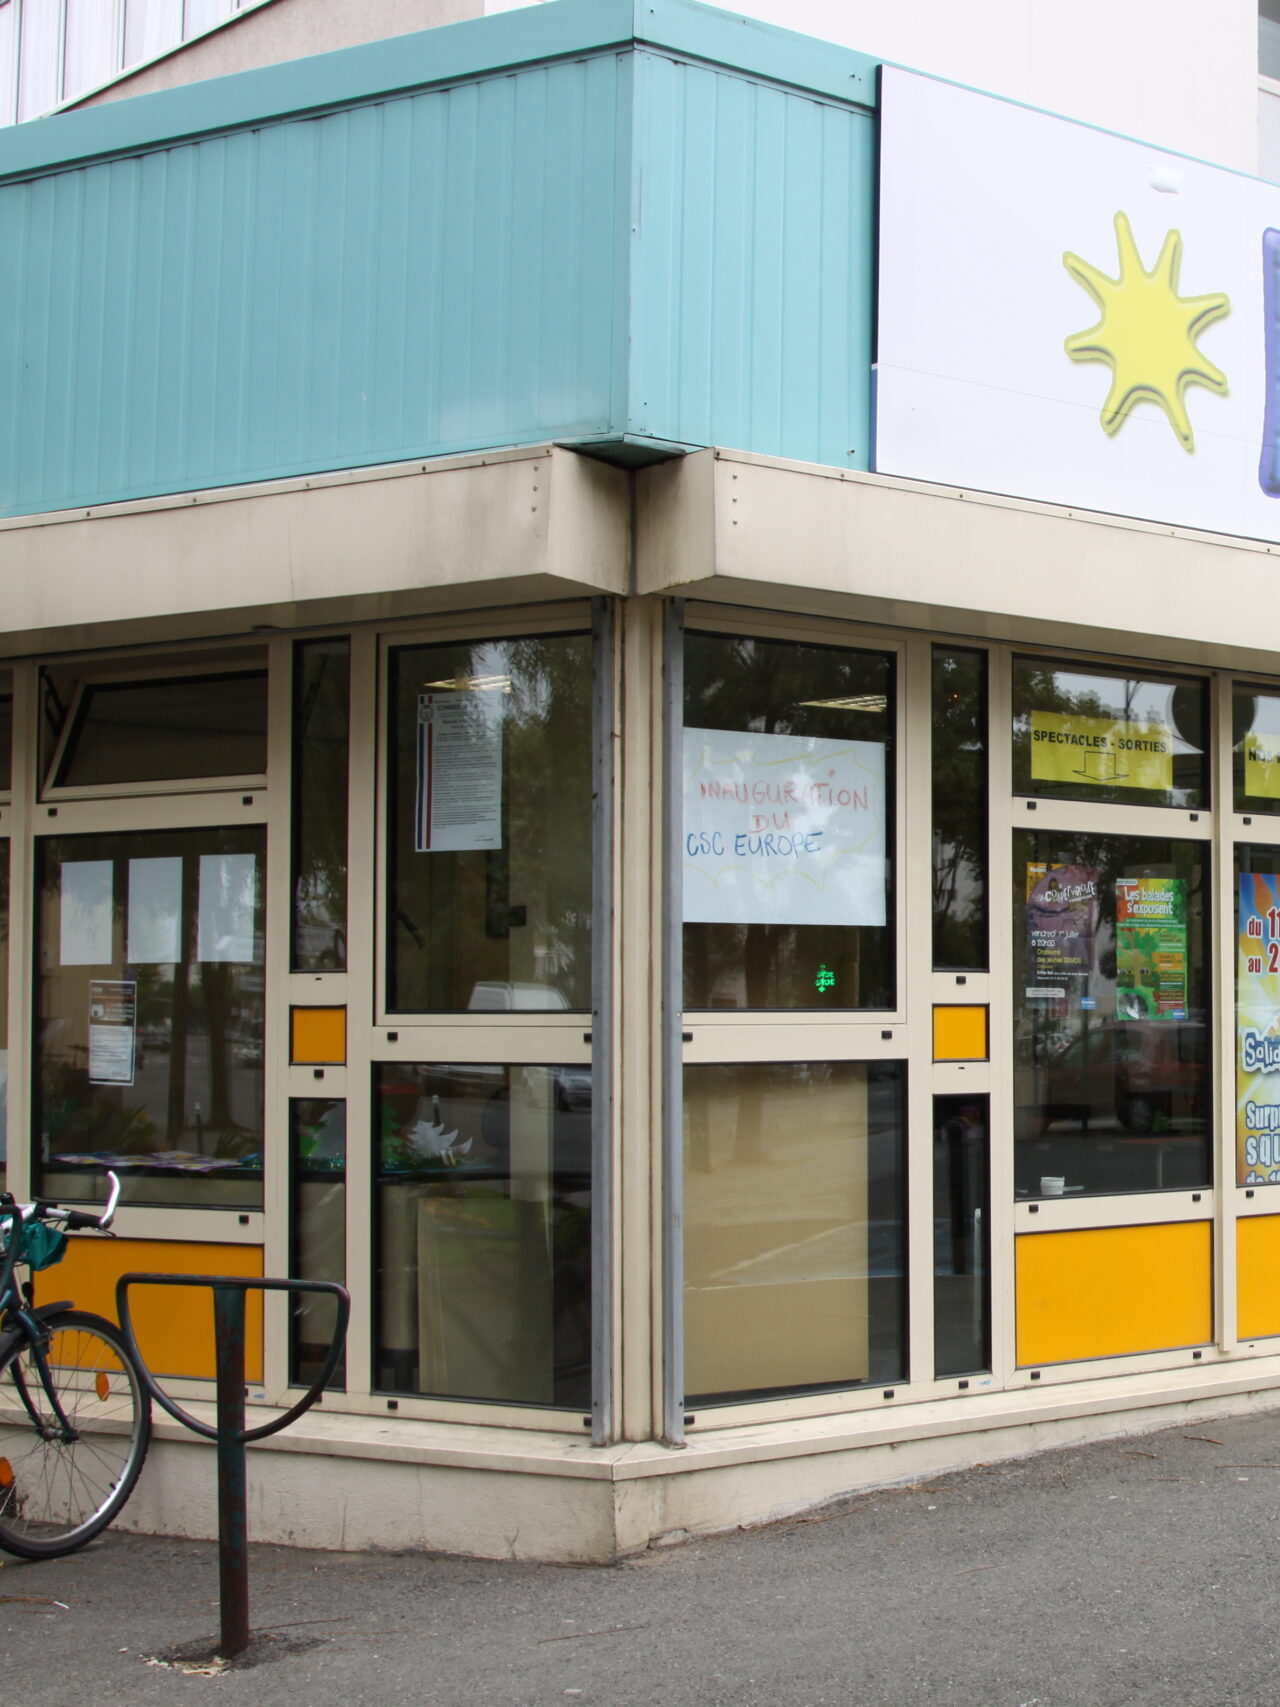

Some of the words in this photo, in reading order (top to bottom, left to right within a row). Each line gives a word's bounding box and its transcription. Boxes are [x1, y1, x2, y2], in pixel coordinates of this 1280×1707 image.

[1033, 730, 1107, 748] SPECTACLES
[1118, 738, 1167, 753] SORTIES
[700, 770, 869, 811] INAUGURATION
[751, 811, 792, 833] DU
[687, 832, 724, 857] CSC
[735, 832, 823, 859] EUROPE
[1124, 886, 1140, 900] Les
[1141, 887, 1174, 902] balades
[1127, 902, 1174, 917] s'exposent
[1248, 917, 1262, 937] du
[1248, 957, 1261, 973] au
